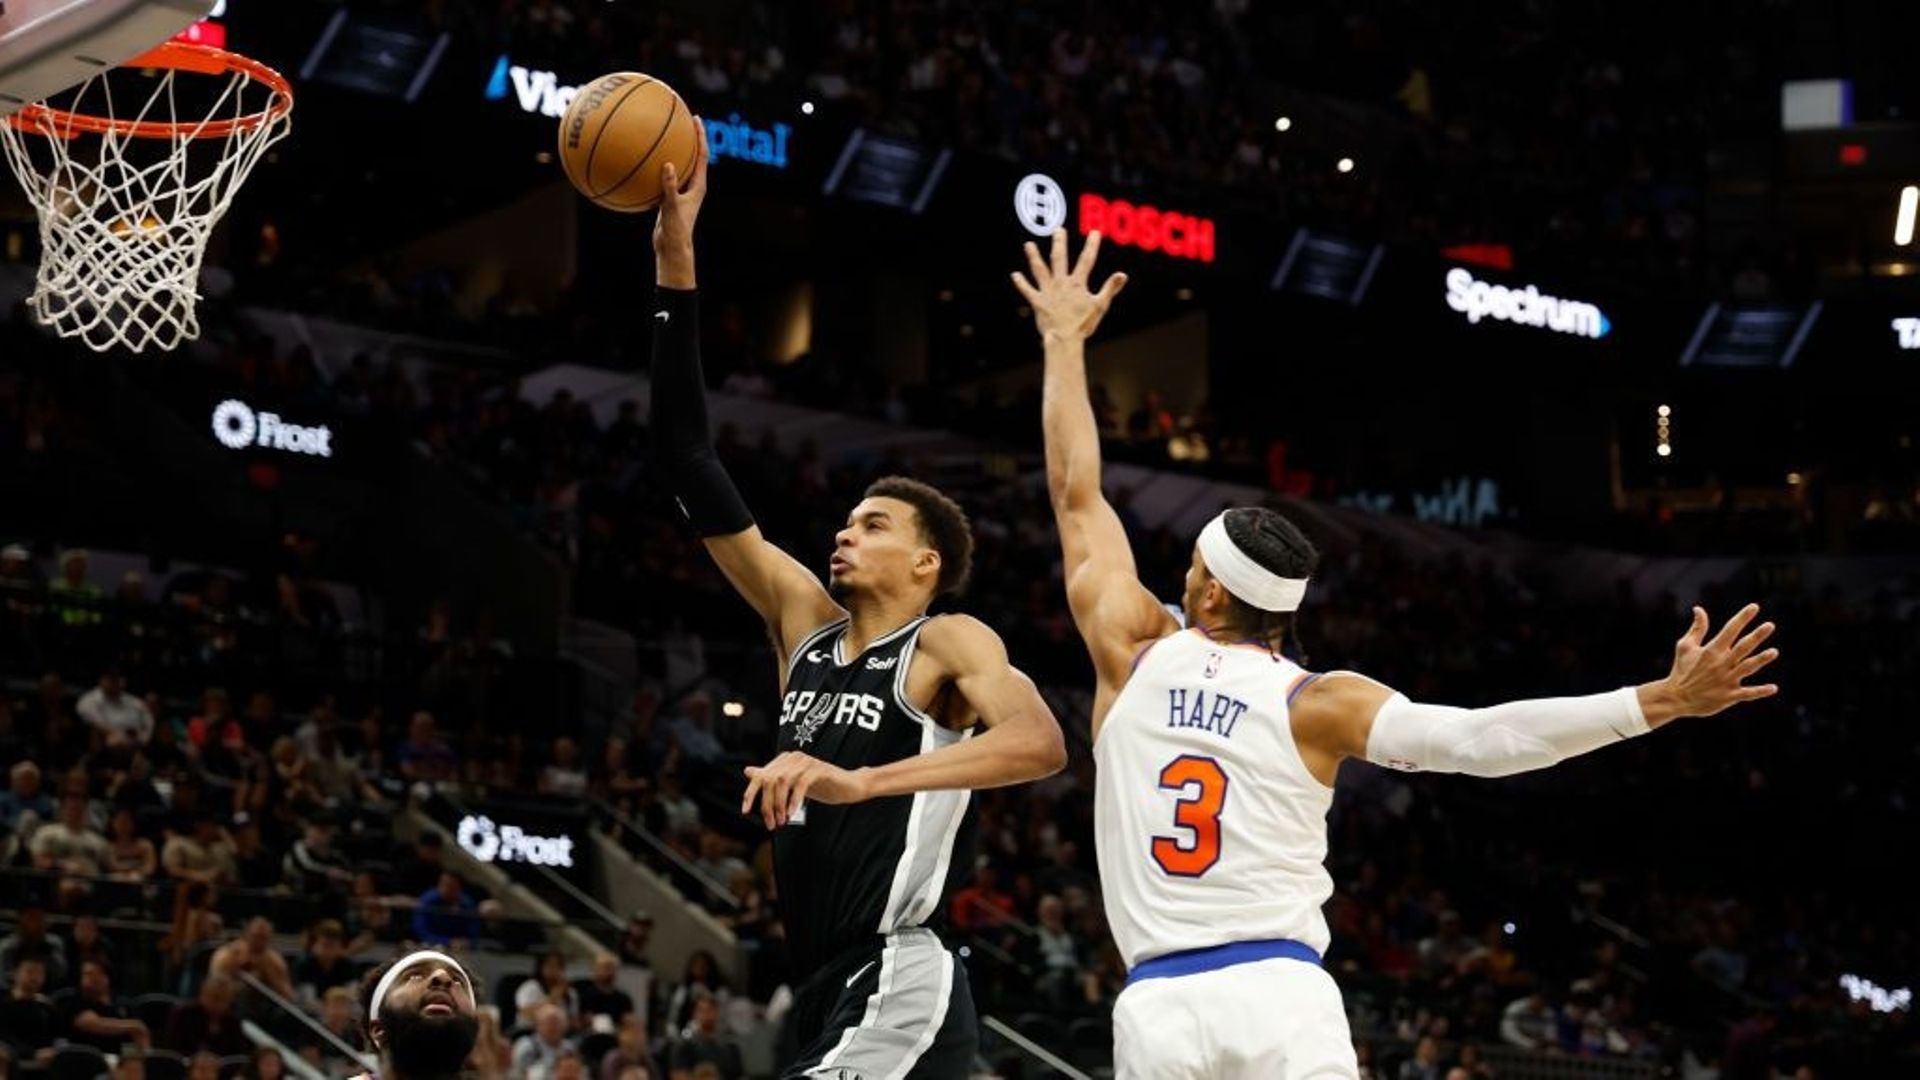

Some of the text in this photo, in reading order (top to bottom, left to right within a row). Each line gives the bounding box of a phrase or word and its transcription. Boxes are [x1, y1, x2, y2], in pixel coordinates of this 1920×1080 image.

[704, 112, 789, 168] pital
[1078, 192, 1215, 262] BOSCH
[1446, 267, 1602, 340] Spectrum
[257, 411, 333, 457] Frost
[865, 656, 898, 670] Self
[779, 690, 884, 740] SPURS
[1167, 688, 1248, 739] HART
[1151, 753, 1229, 878] 3
[498, 824, 574, 869] Frost
